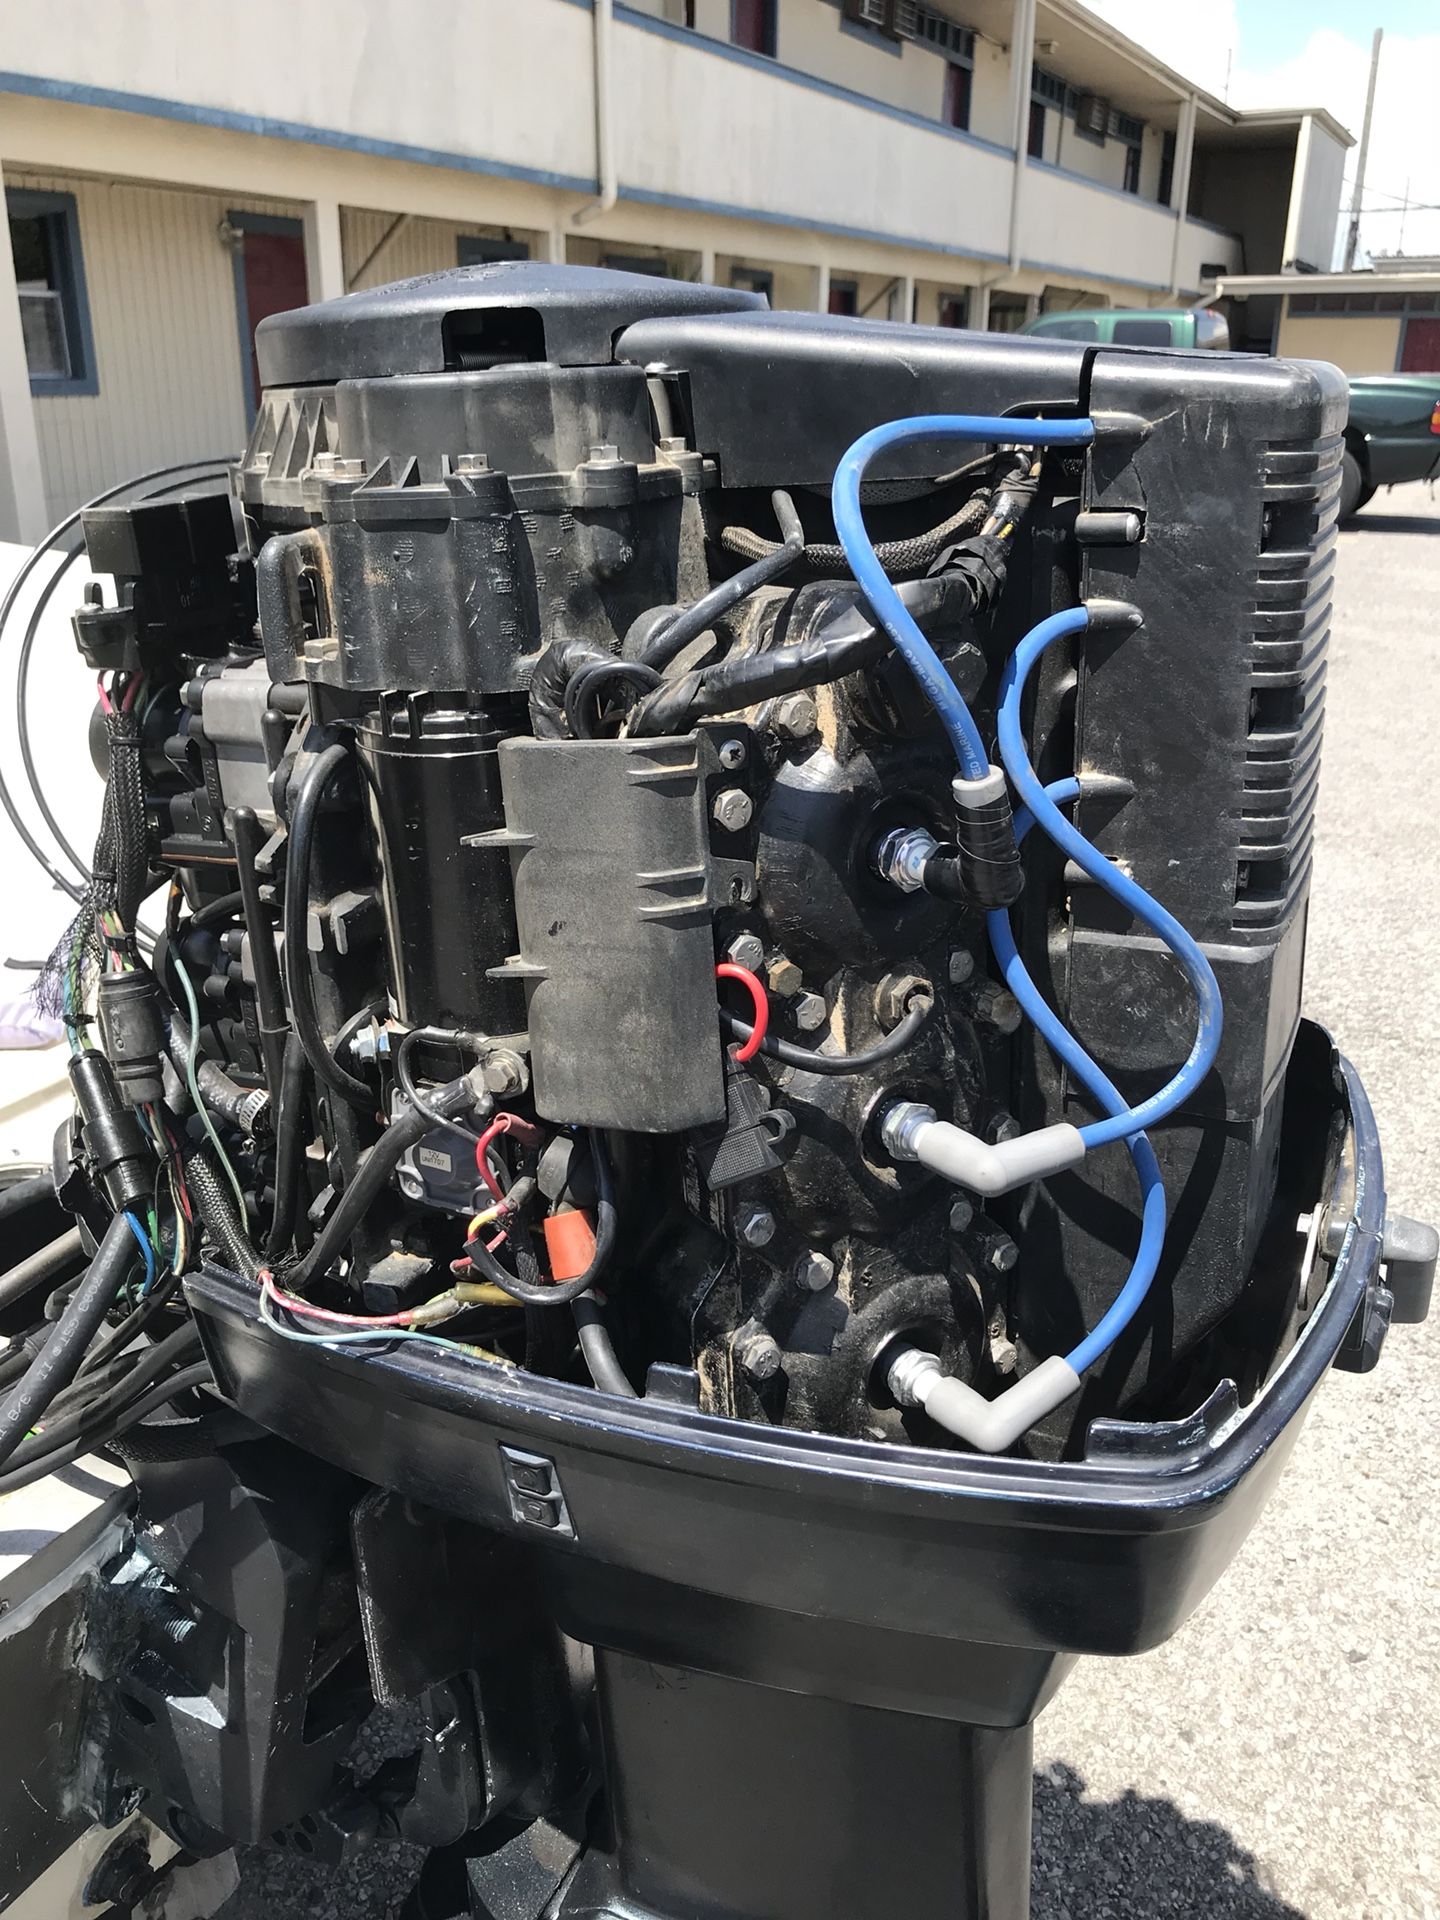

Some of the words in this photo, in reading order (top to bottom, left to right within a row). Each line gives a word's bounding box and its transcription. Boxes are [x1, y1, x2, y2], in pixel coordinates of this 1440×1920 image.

[954, 721, 977, 759] MARINE
[1129, 1097, 1159, 1118] UNITED
[1158, 1074, 1185, 1102] MARINE
[7, 1394, 32, 1422] 3/8
